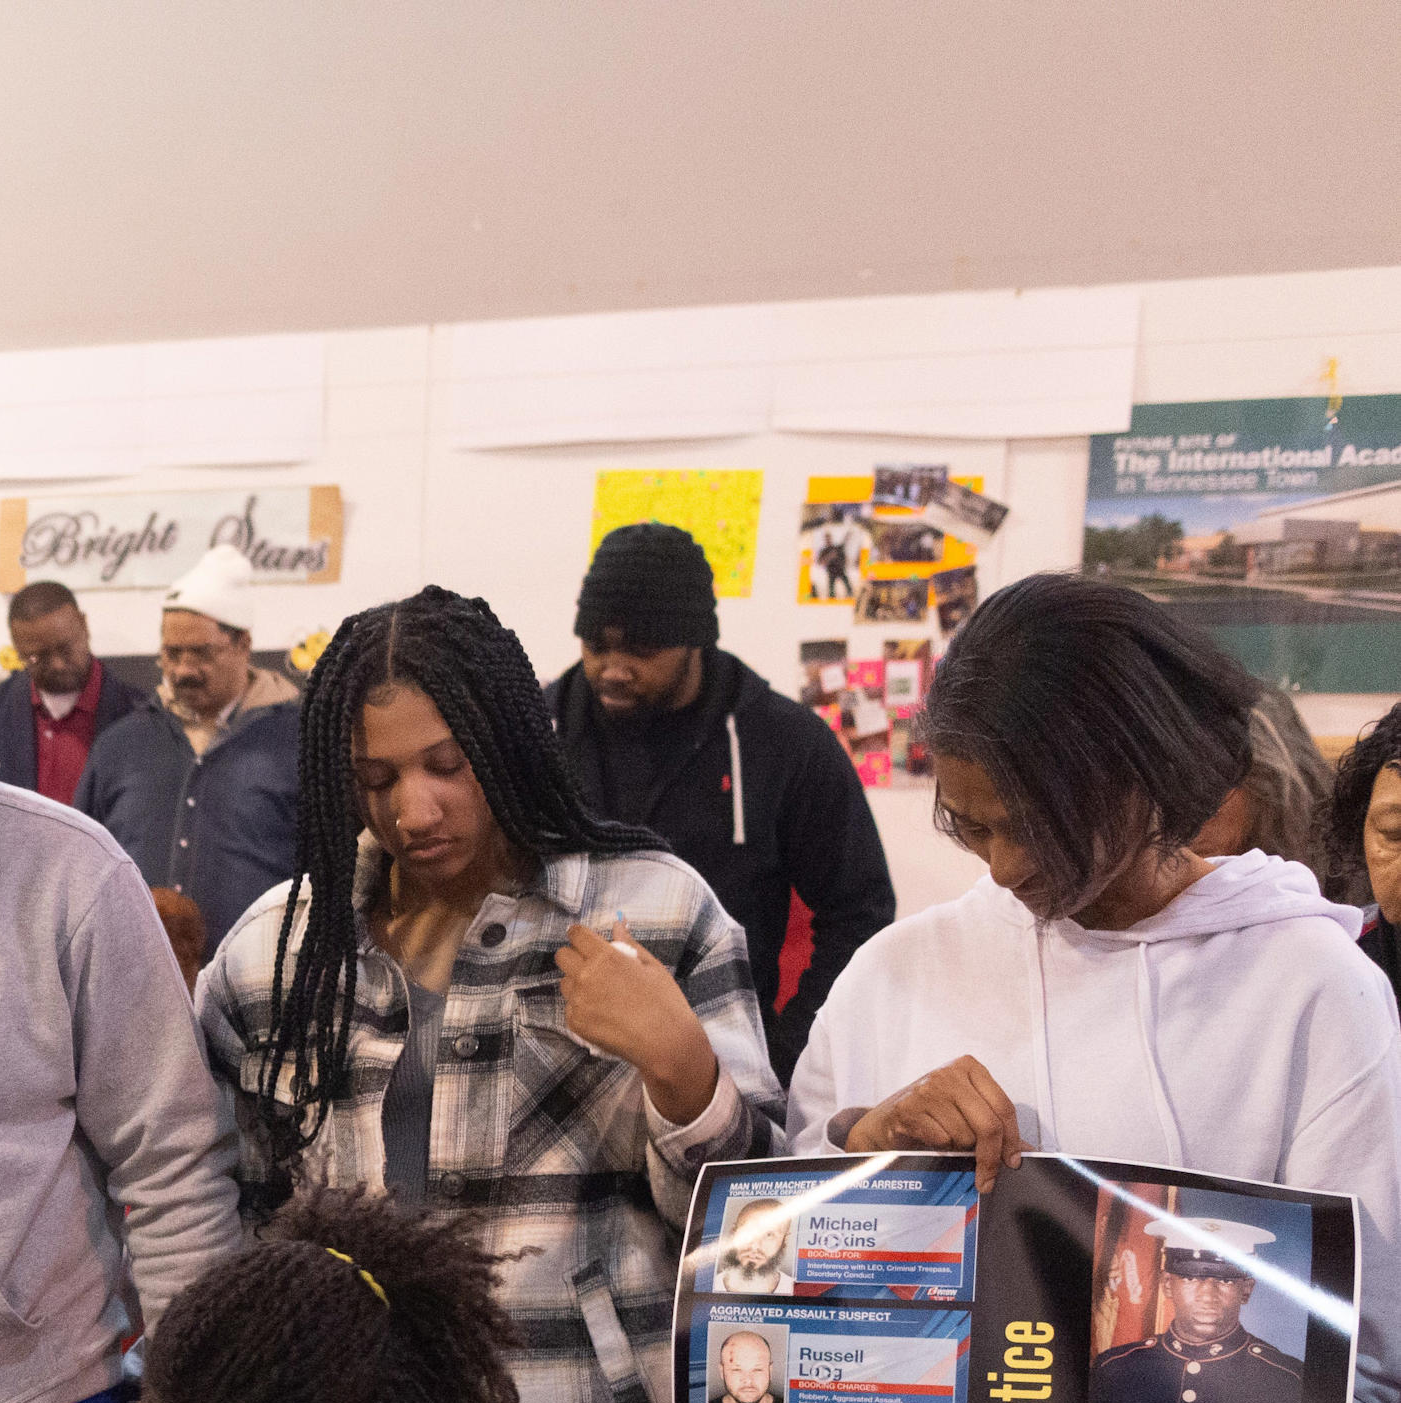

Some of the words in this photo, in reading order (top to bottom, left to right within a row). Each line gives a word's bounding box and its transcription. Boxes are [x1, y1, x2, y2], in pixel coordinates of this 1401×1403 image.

[1114, 451, 1161, 474] The
[1167, 445, 1332, 472] International
[1144, 471, 1258, 492] Tennessee
[1266, 469, 1319, 489] Town
[19, 509, 178, 582] Bright
[209, 494, 332, 572] Stars
[730, 1182, 750, 1191] MAN
[751, 1181, 774, 1191] WITH
[775, 1180, 817, 1190] MACHETE
[871, 1180, 923, 1191] ARRESTED
[809, 1216, 878, 1231] Michael
[807, 1250, 841, 1258] BOOKED
[806, 1270, 842, 1279] Disorderly
[843, 1271, 875, 1279] Conduct
[807, 1262, 849, 1270] Interference
[850, 1263, 866, 1271] with
[867, 1264, 885, 1272] LEO,
[886, 1264, 916, 1272] Criminal
[918, 1265, 953, 1274] Trespass,
[709, 1305, 784, 1317] AGGRAVATED
[785, 1308, 836, 1320] ASSAULT
[838, 1311, 892, 1321] SUSPECT
[799, 1347, 864, 1363] Russell
[798, 1380, 835, 1390] BOOKING
[837, 1382, 878, 1392] CHARGES:
[798, 1392, 831, 1401] Robbery,
[832, 1394, 873, 1403] Aggravated
